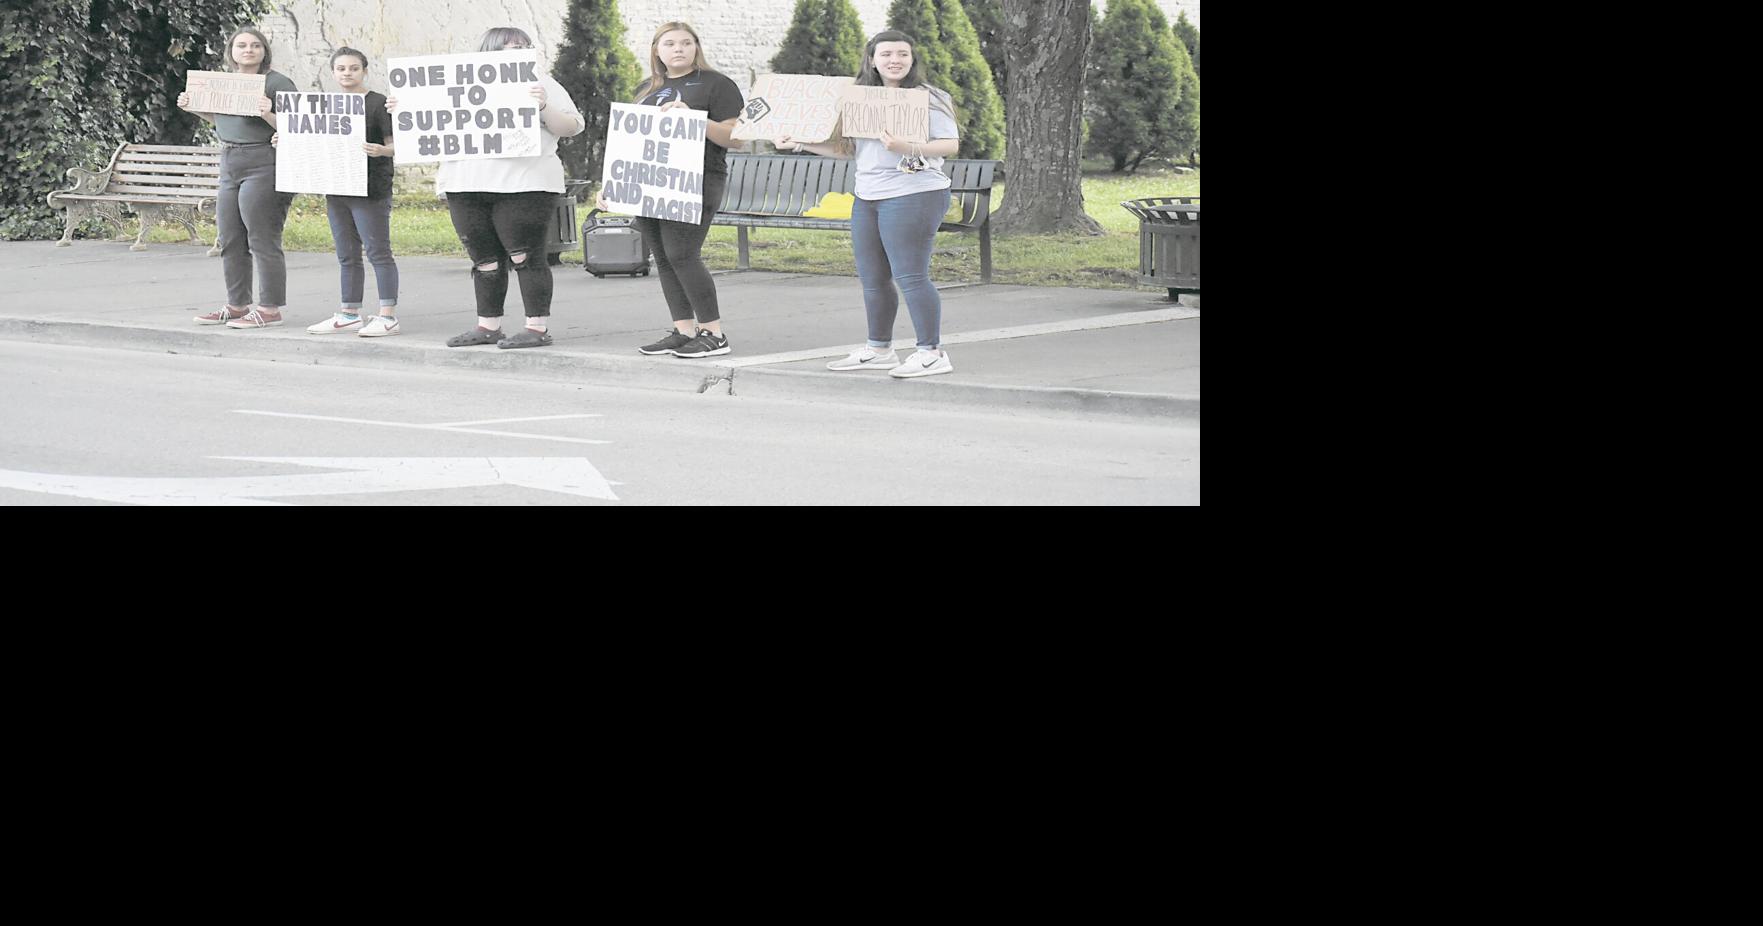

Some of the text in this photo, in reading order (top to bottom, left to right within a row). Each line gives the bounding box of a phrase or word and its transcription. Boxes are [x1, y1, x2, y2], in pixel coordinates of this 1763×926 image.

[389, 61, 538, 88] ONE HONK
[448, 85, 487, 108] TO
[768, 77, 838, 100] BLACK
[276, 93, 302, 113] SAY
[307, 94, 364, 115] THEIR
[772, 101, 832, 121] LIVES
[288, 114, 352, 135] NAMES
[398, 107, 536, 131] SUPPORT
[612, 109, 653, 135] YOU
[739, 121, 829, 137] MATTER
[844, 102, 929, 144] BREONNA TAYLOR
[418, 133, 502, 156] #BLM
[643, 139, 670, 164] BE
[611, 159, 703, 195] CHRISTIAN
[603, 180, 702, 225] AND RACIST
